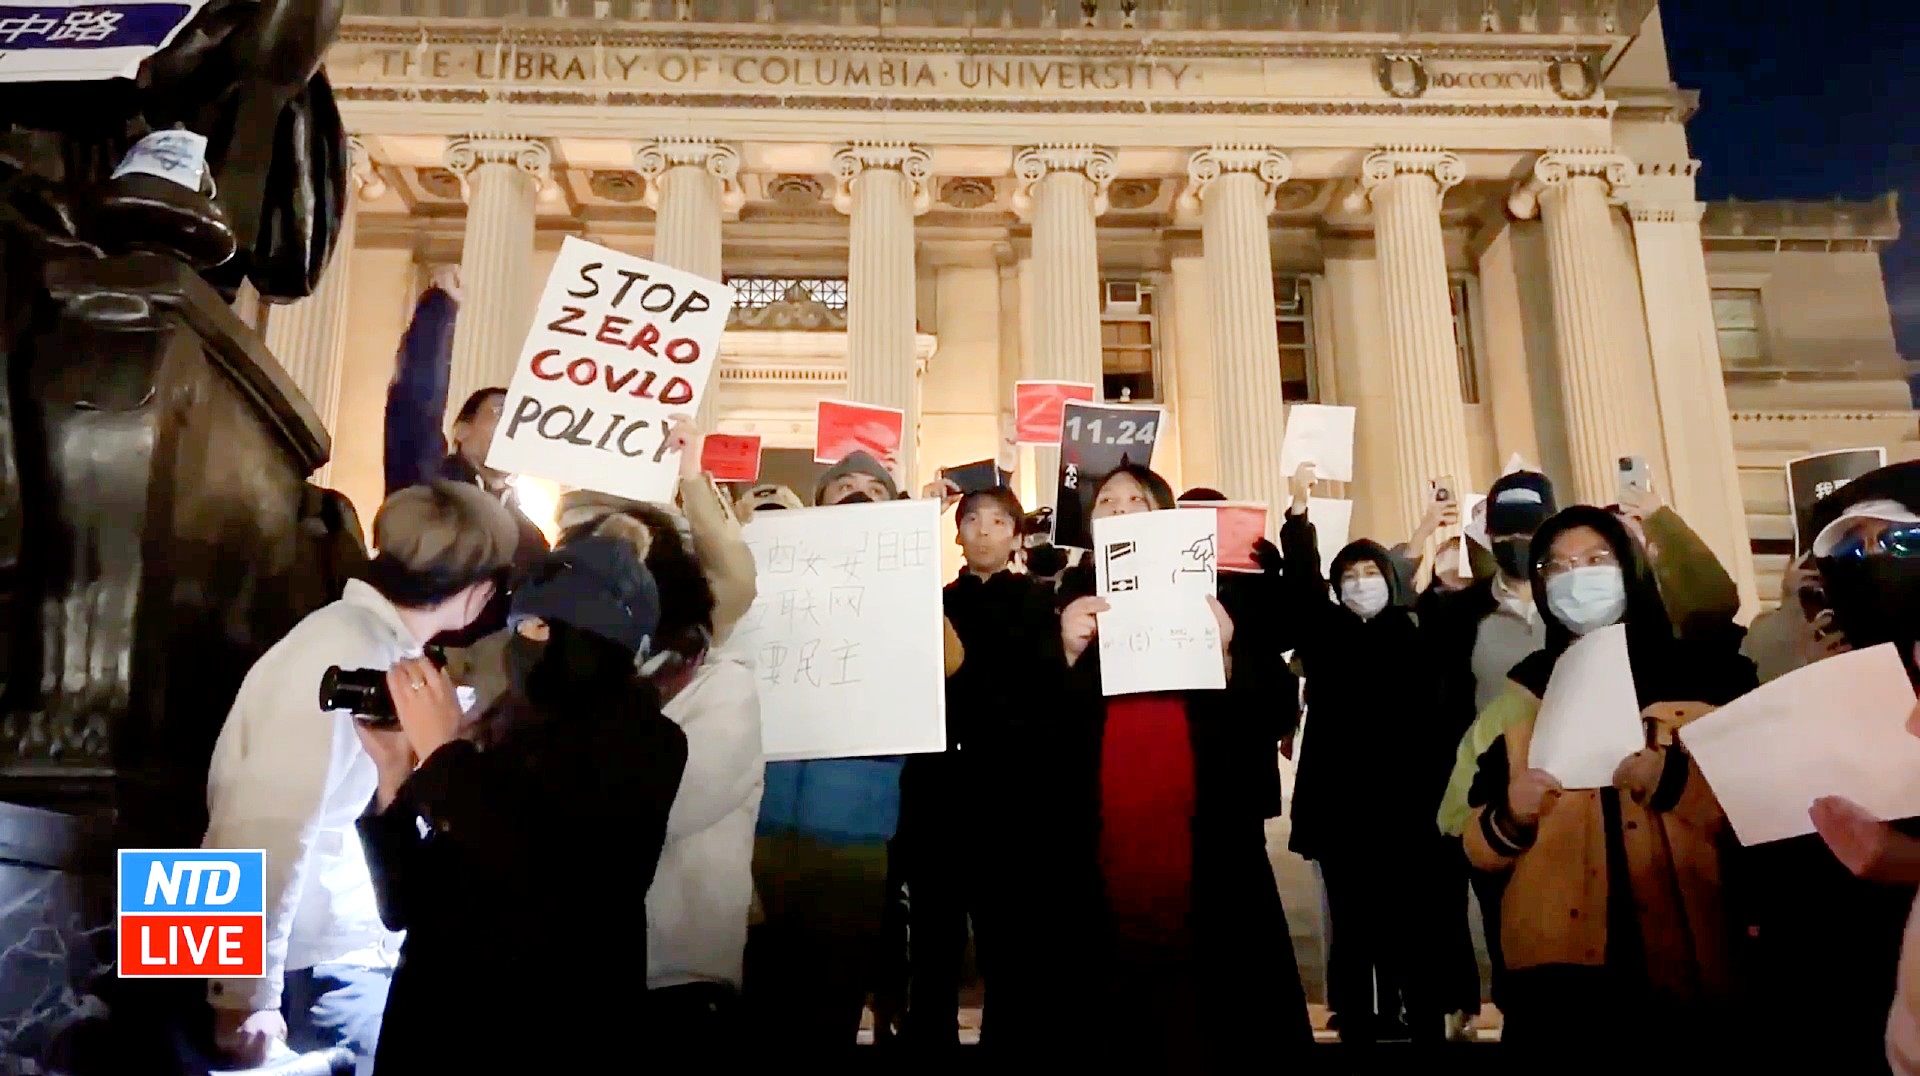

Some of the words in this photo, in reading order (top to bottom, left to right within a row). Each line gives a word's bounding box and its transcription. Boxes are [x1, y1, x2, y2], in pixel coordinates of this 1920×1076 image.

[376, 50, 450, 79] THE
[657, 54, 712, 83] OF
[733, 56, 936, 88] COLUMBIA
[958, 61, 1190, 90] UNIVERSITY
[567, 262, 710, 323] STOP
[548, 305, 701, 364] ZERO
[530, 349, 693, 405] COVID
[505, 395, 673, 463] POLICY
[1066, 416, 1155, 445] 11.24
